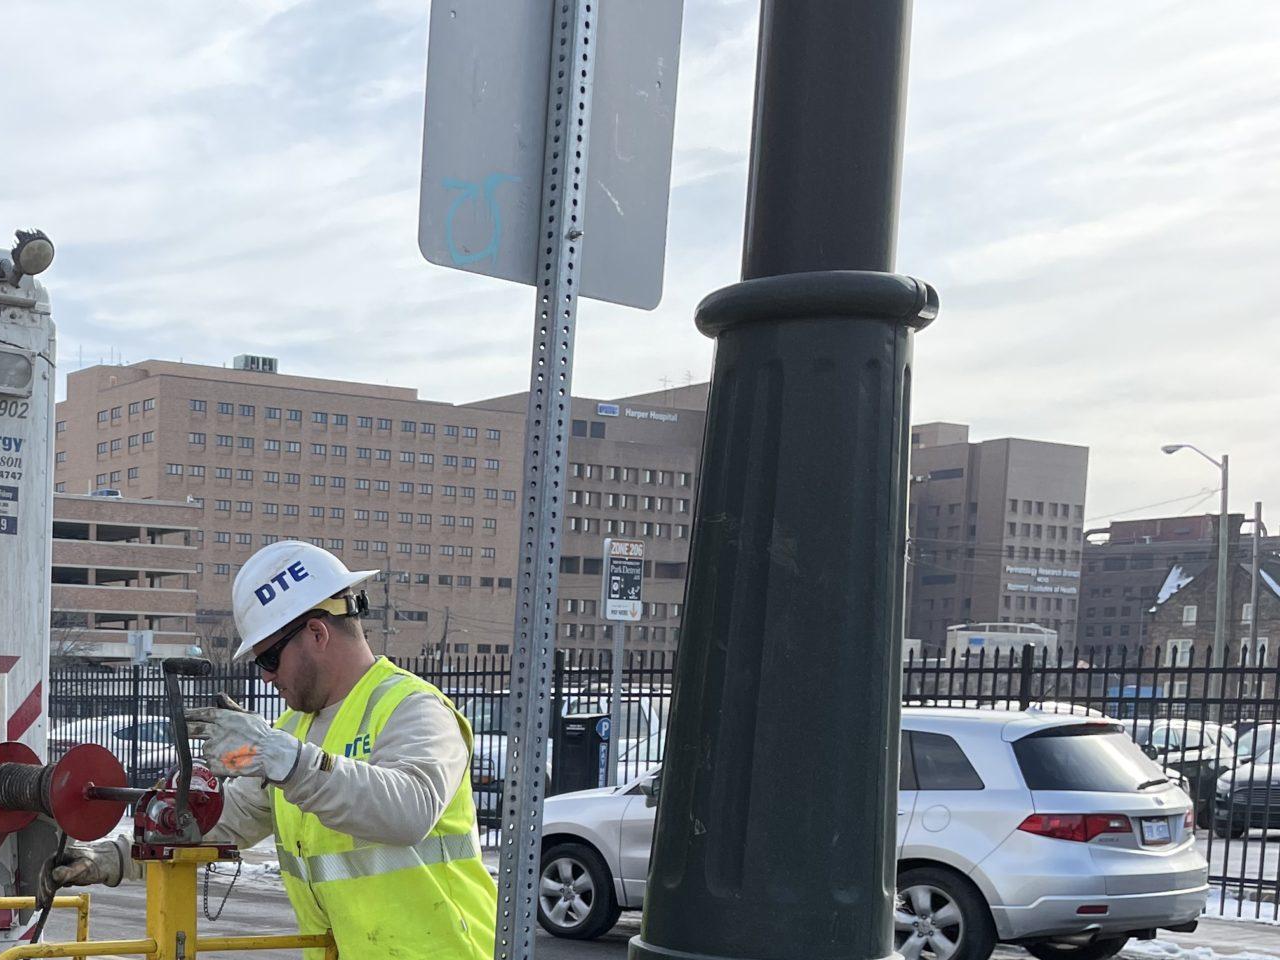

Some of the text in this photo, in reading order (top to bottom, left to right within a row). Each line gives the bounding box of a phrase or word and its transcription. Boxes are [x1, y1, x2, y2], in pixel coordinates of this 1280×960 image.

[625, 407, 648, 419] Harper
[649, 410, 678, 422] Hospital
[611, 542, 629, 555] ZONE
[254, 560, 309, 606] DTE
[602, 721, 609, 737] P
